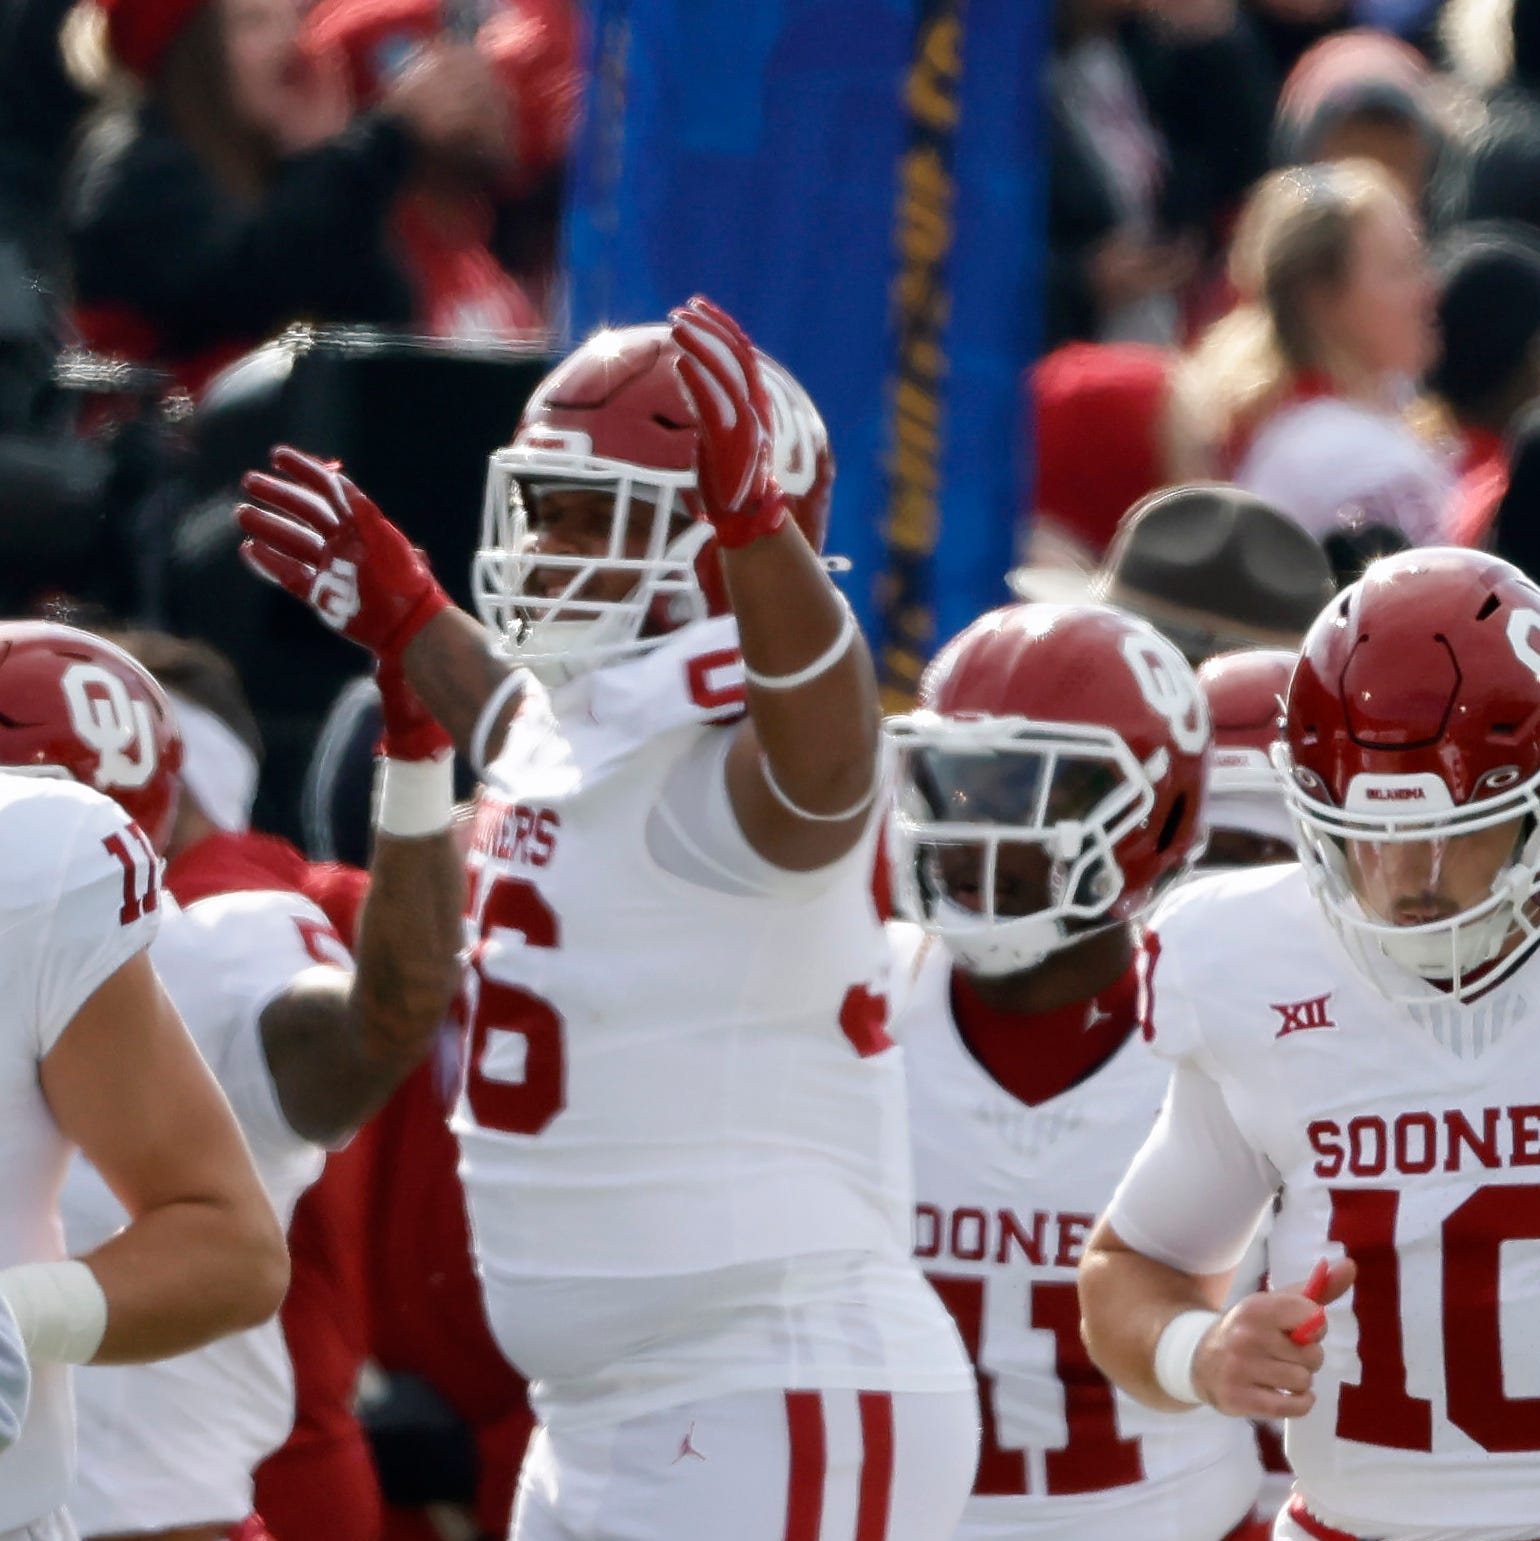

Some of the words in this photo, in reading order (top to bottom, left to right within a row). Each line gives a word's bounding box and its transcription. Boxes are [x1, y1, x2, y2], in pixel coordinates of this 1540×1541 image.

[60, 662, 158, 788] OU
[1121, 630, 1212, 755] OU
[462, 860, 569, 1138] 6
[1269, 992, 1337, 1039] XII
[913, 1202, 1097, 1268] OONE
